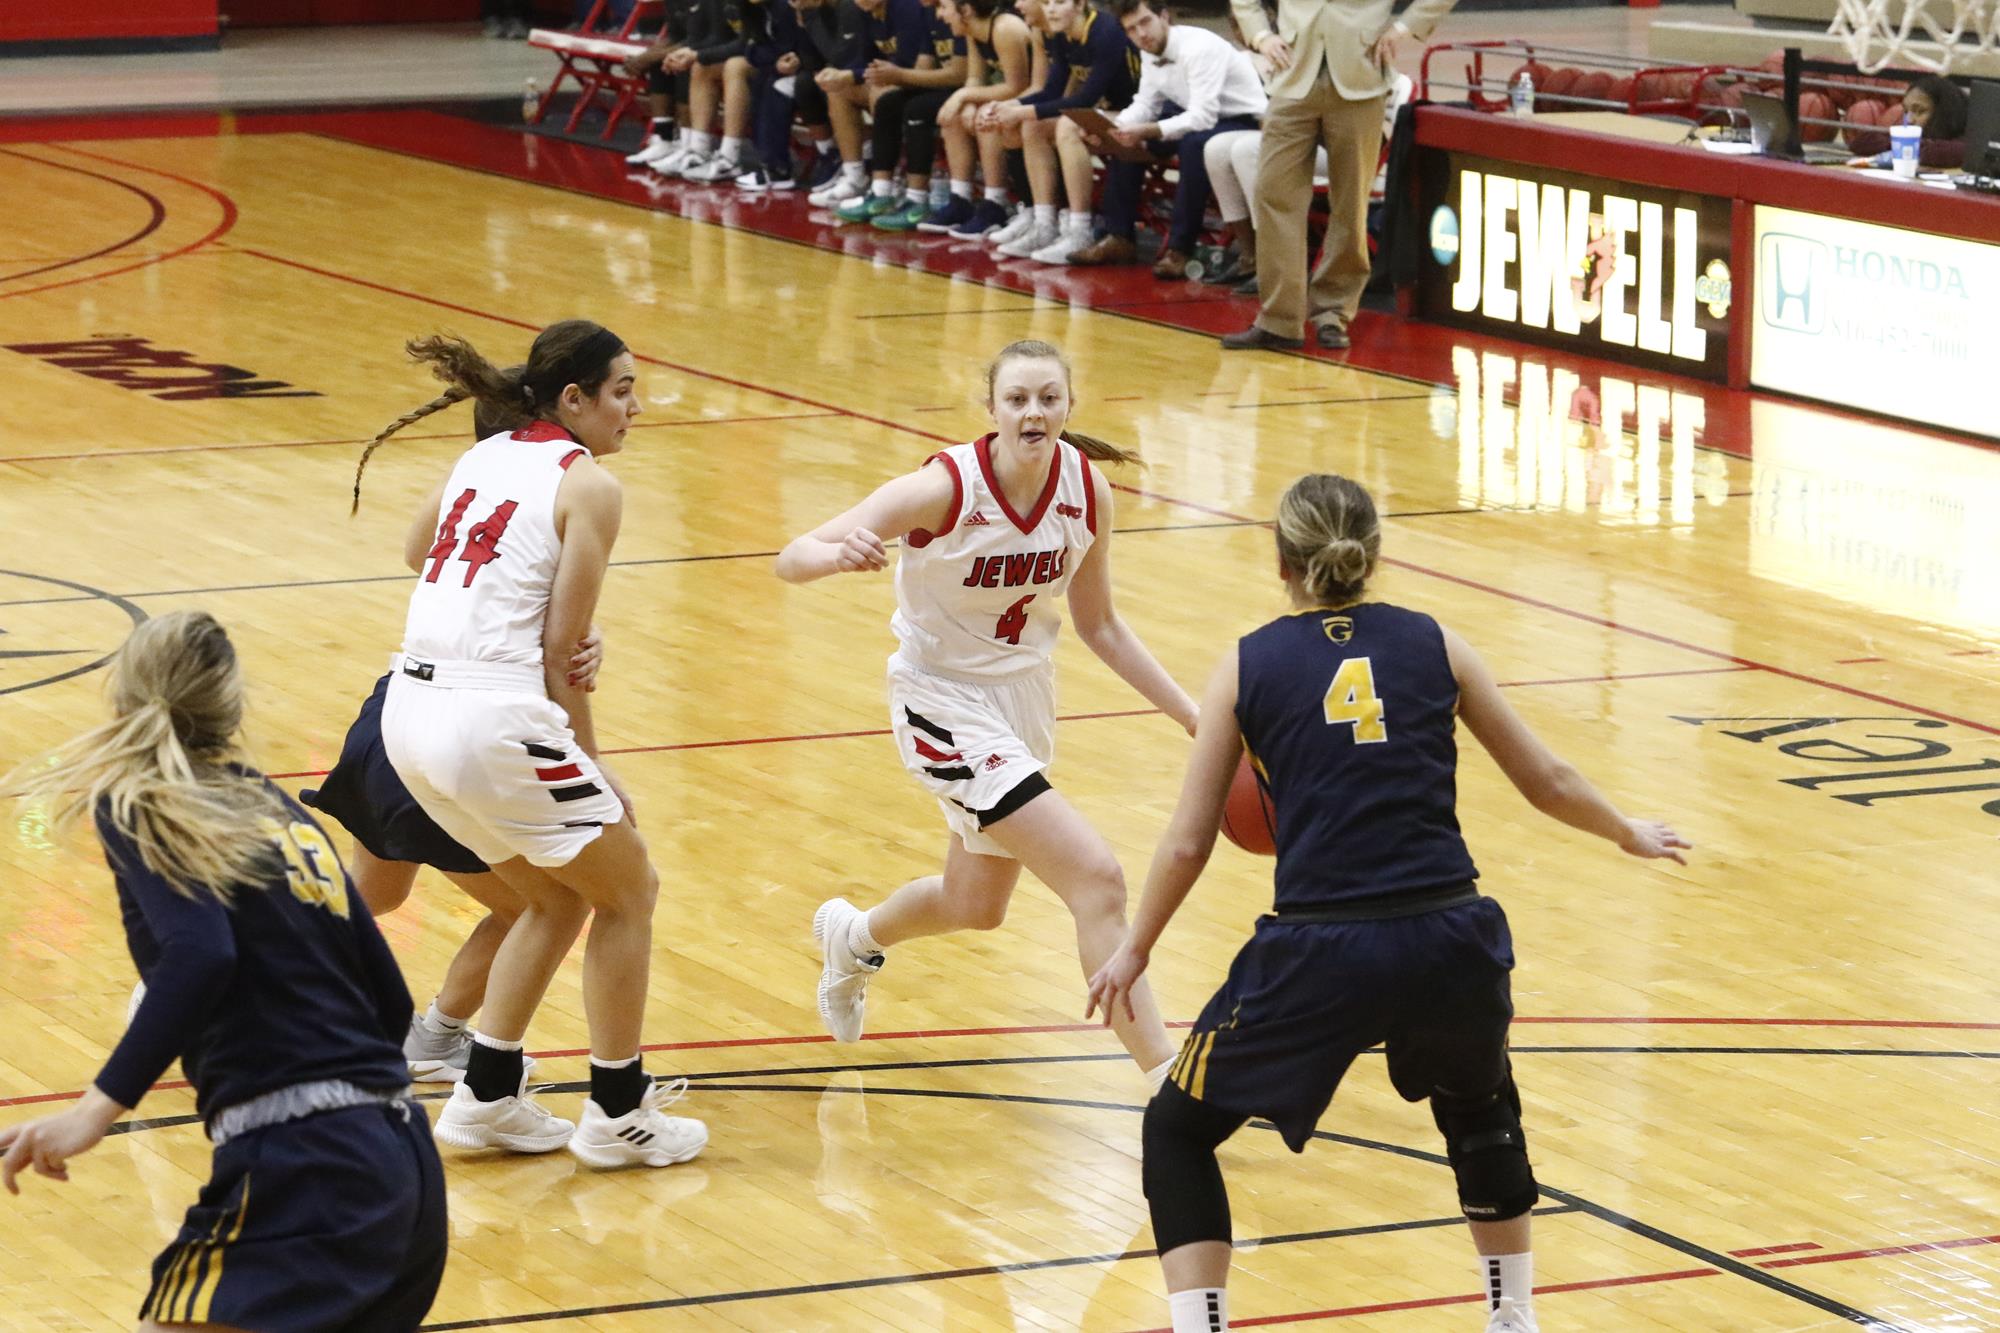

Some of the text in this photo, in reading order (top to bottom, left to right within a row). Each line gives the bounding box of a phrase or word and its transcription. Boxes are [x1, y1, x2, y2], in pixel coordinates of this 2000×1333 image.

[1452, 169, 1707, 361] JEWELL
[1834, 245, 1969, 299] HONDA
[425, 488, 519, 588] 44
[995, 593, 1037, 645] 4
[1323, 656, 1388, 744] 4
[1667, 715, 2000, 817] lley
